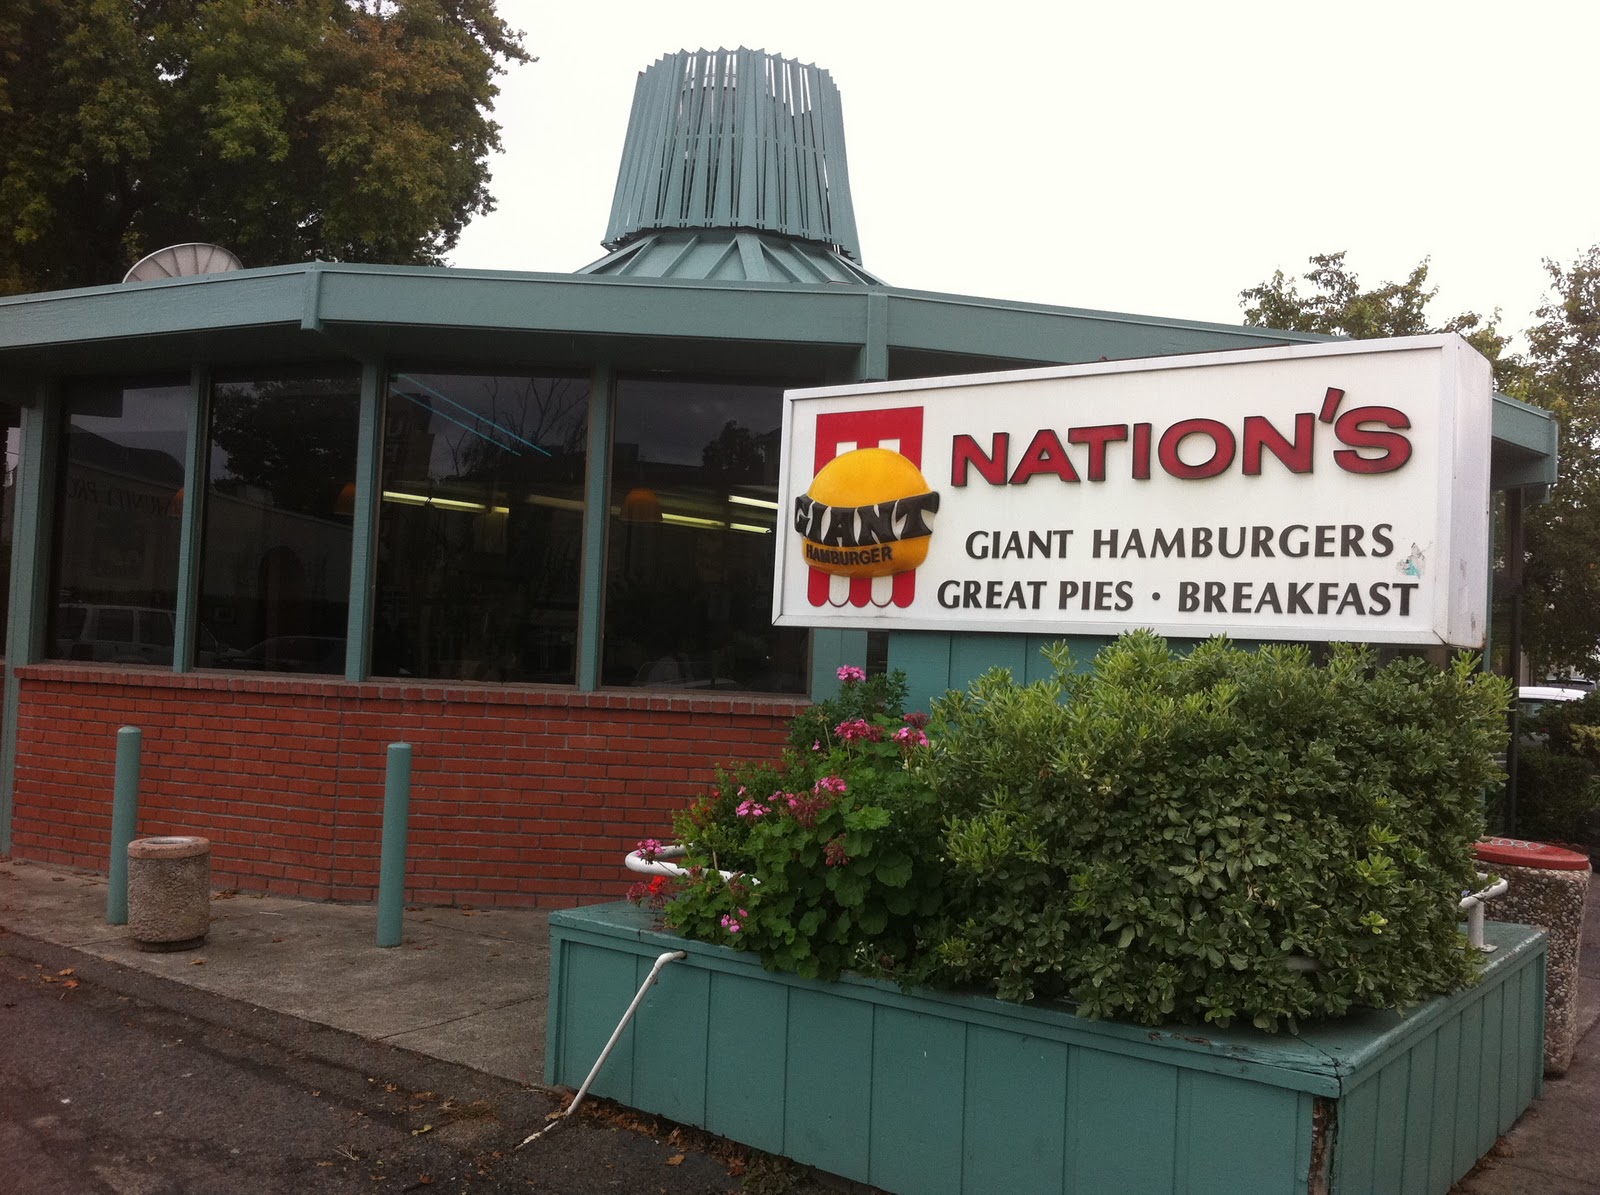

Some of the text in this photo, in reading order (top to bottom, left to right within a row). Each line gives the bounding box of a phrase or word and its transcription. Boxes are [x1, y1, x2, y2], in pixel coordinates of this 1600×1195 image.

[951, 387, 1413, 488] NATION'S
[794, 491, 940, 547] GIANT
[806, 544, 893, 566] HAMBURGER
[965, 523, 1394, 560] GIANT HAMBURGERS
[937, 579, 1419, 617] GREAT PIES BREAKFAST
